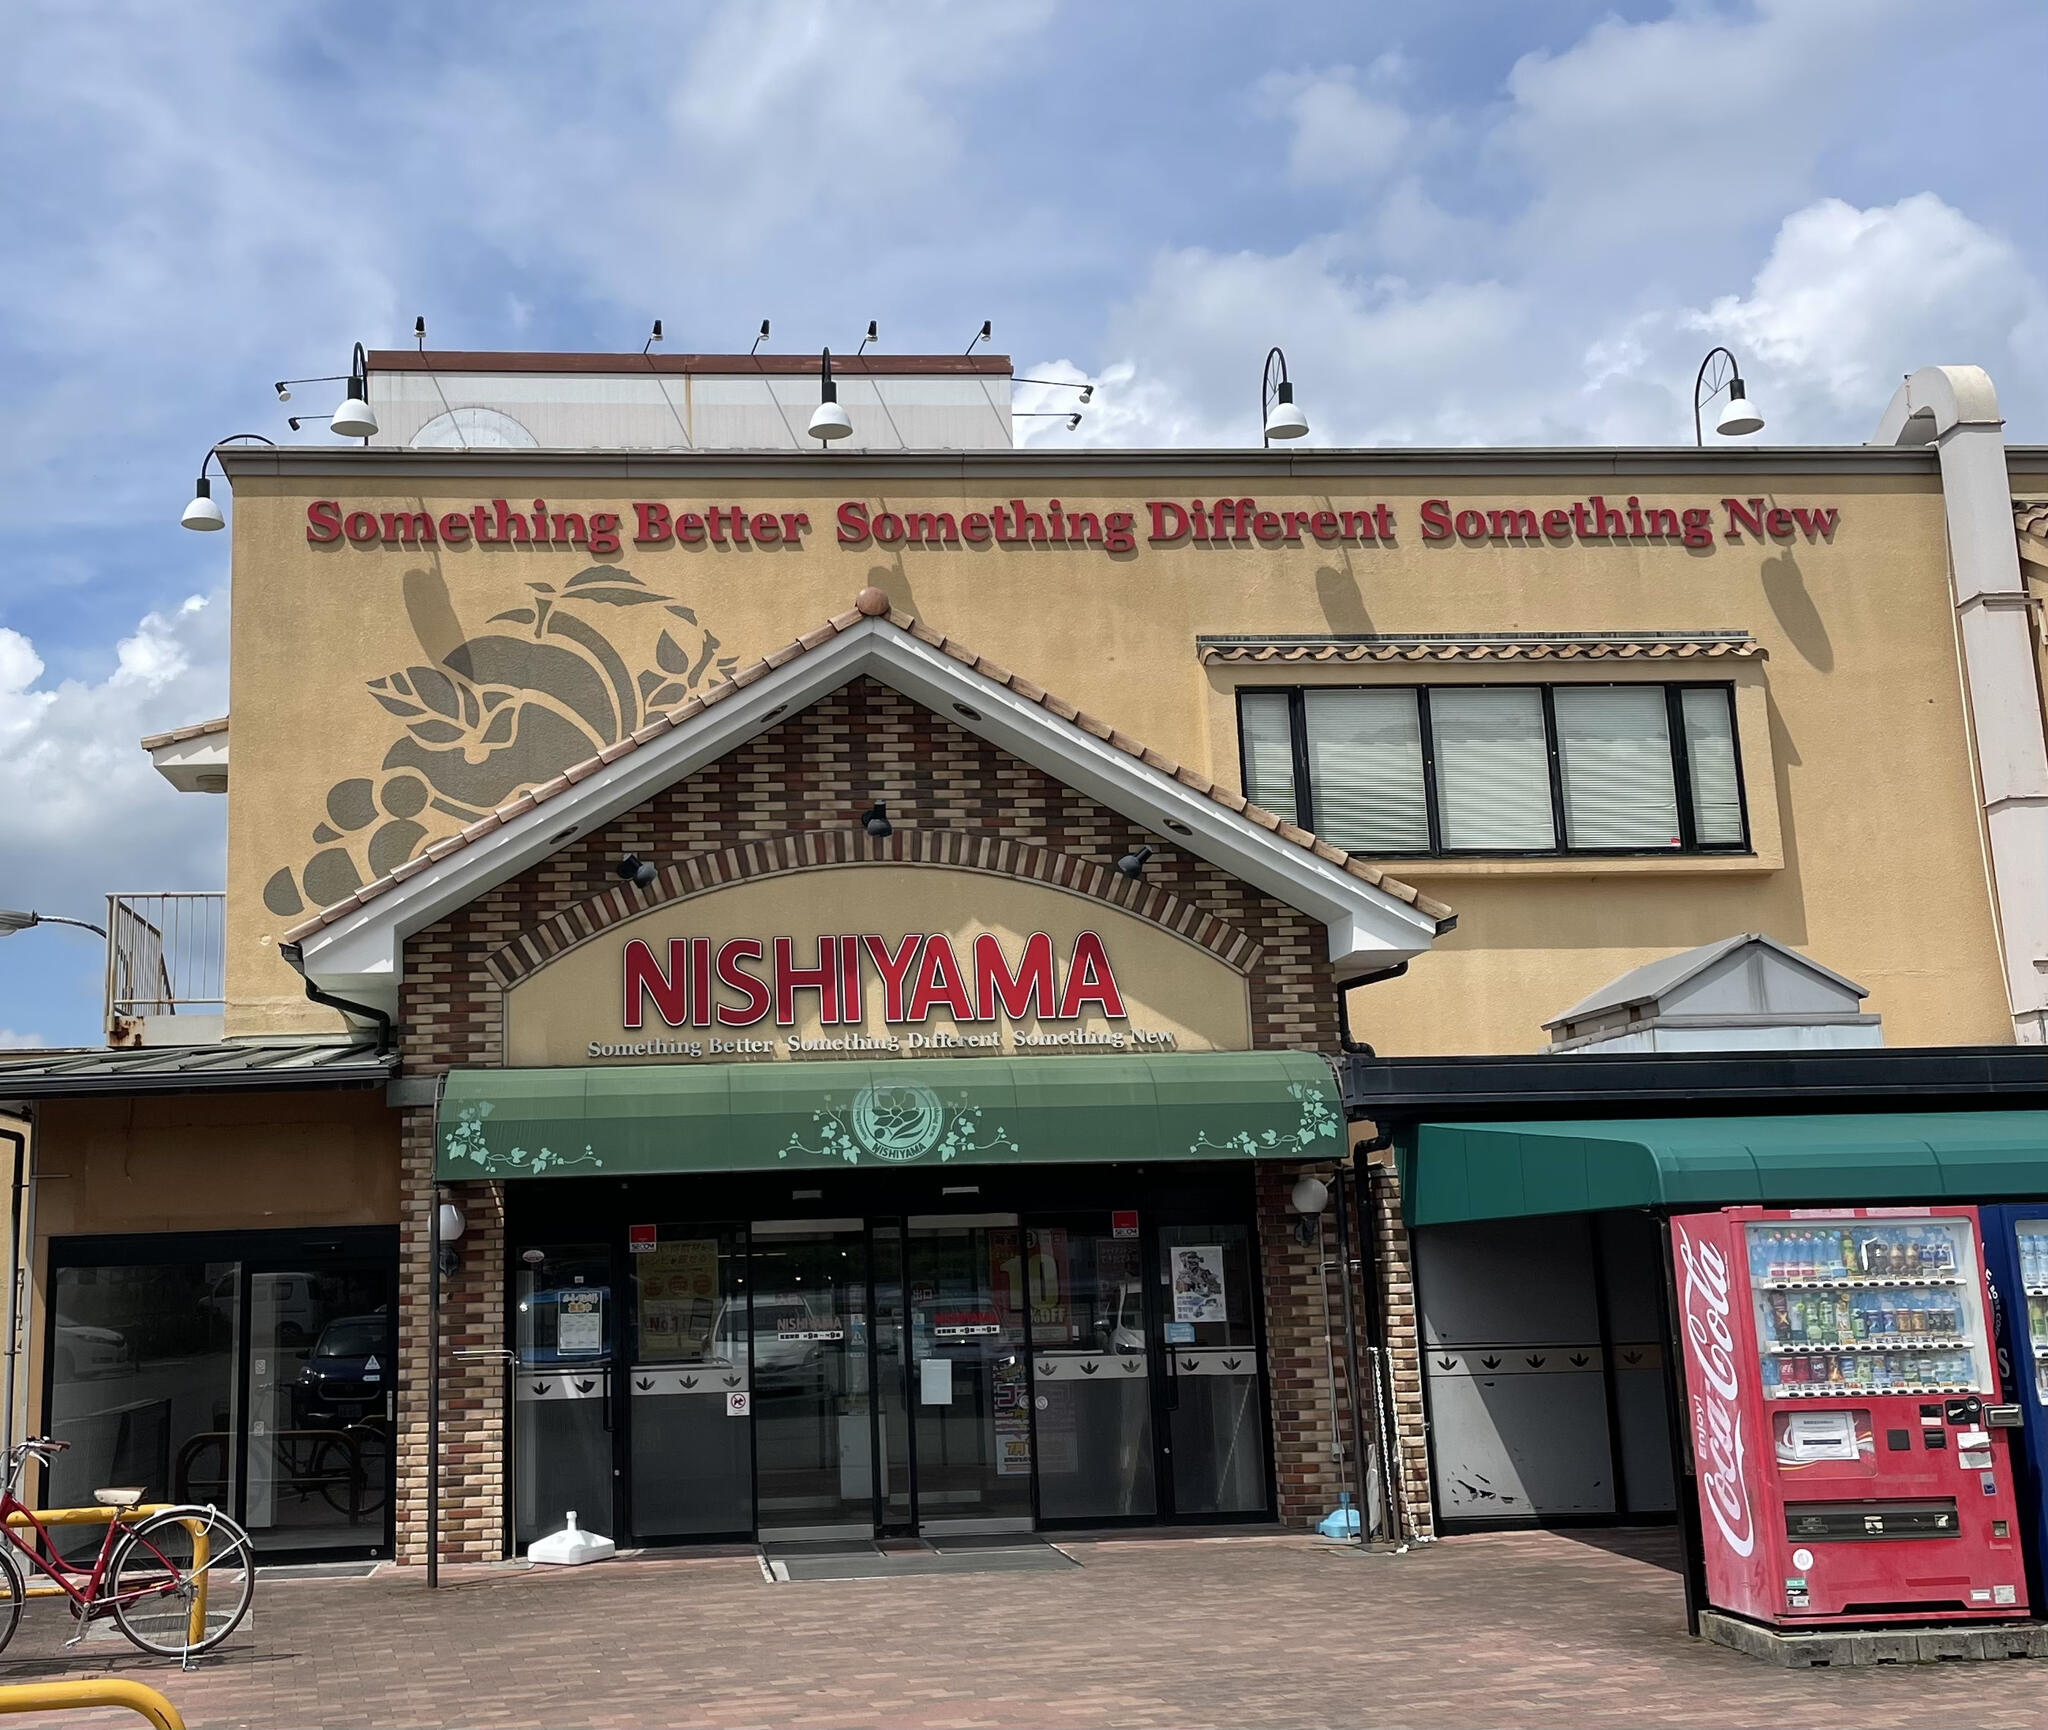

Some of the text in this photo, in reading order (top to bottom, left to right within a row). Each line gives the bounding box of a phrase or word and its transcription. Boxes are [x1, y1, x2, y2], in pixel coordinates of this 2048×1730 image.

[306, 495, 1840, 553] Something Better Something Different Something New
[622, 930, 1128, 1029] NISHIYAMA
[588, 1027, 1174, 1058] Something Better Something Different Something New
[872, 1142, 927, 1159] NISHIYAMA
[1678, 1222, 1754, 1557] Coca-Cola
[1694, 1394, 1707, 1460] Enjoy!
